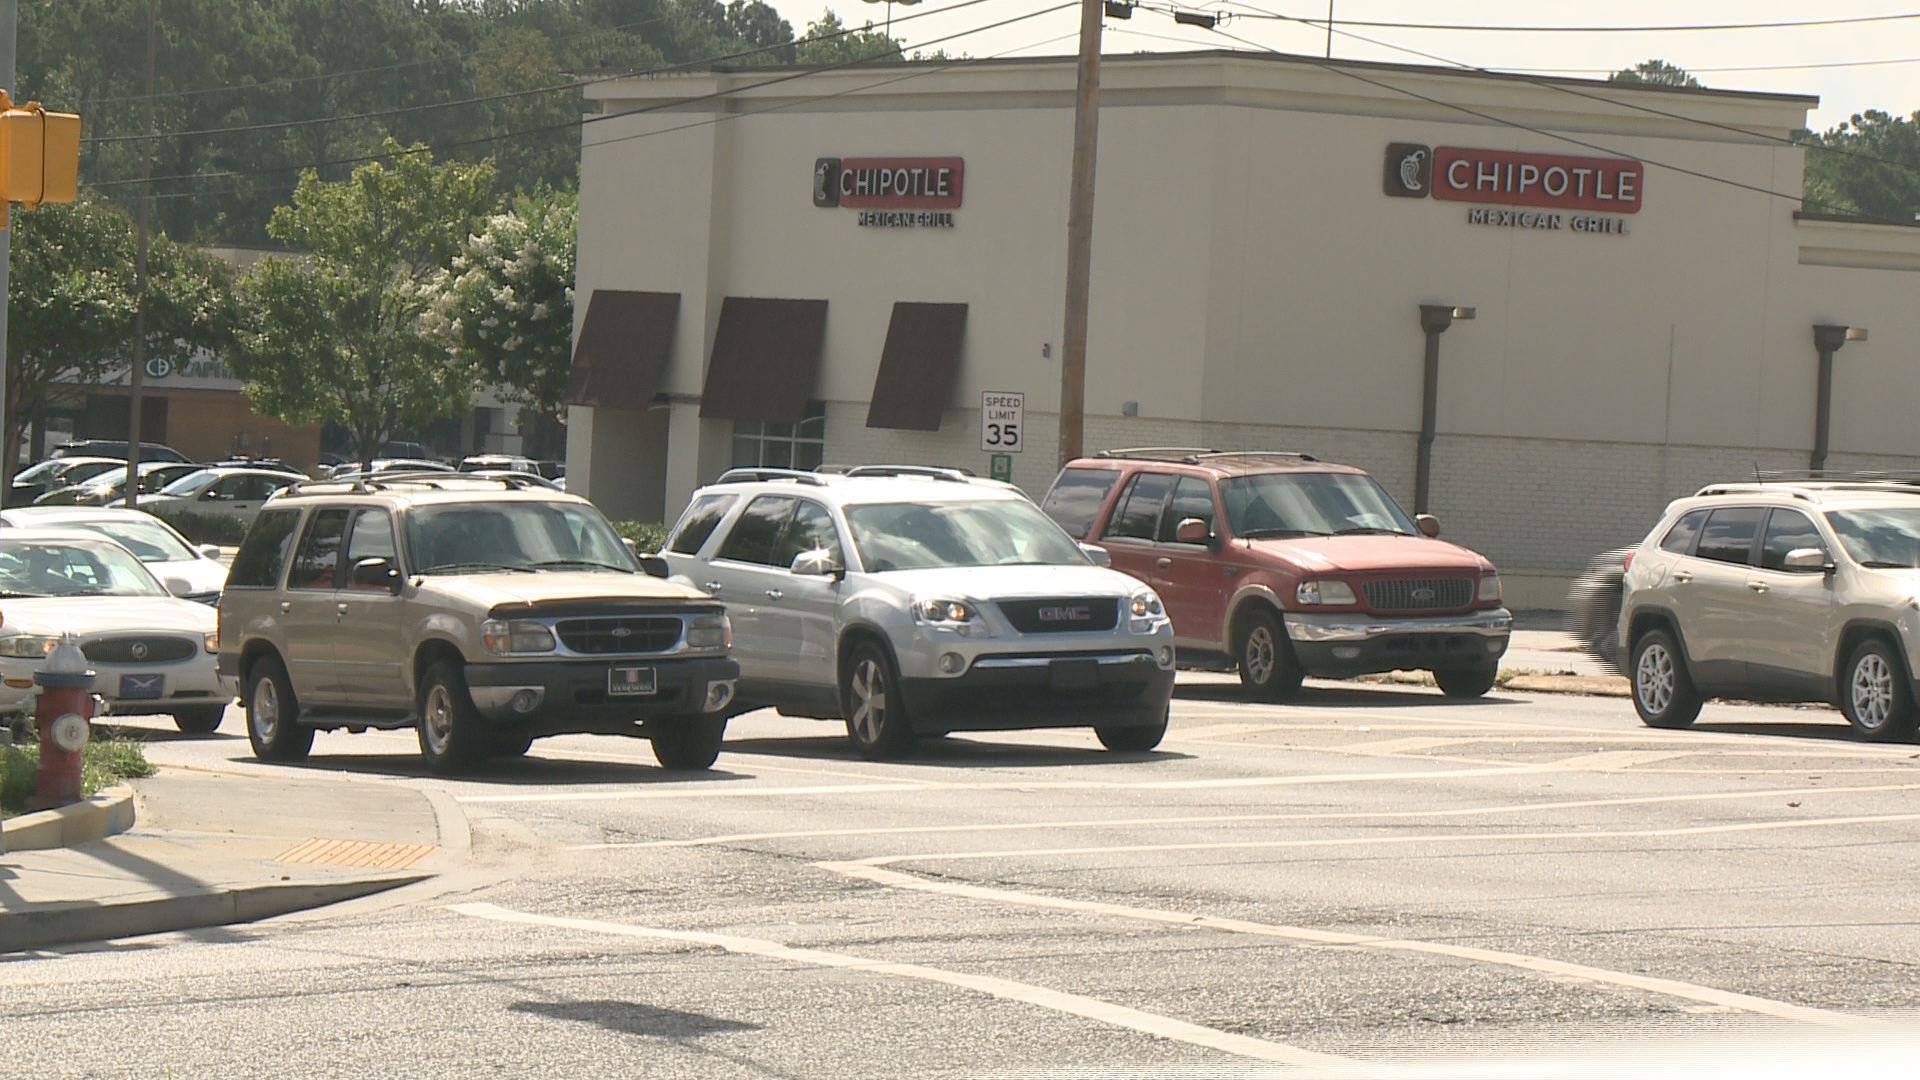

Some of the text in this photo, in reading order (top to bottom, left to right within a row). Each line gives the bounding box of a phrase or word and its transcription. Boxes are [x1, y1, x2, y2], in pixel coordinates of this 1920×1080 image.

[840, 168, 950, 196] CHIPOTLE
[1447, 159, 1638, 201] CHIPOTLE
[858, 211, 954, 228] MEXICAN GRILL
[1468, 208, 1631, 235] MEXICAN GRILL
[985, 397, 1021, 408] SPEED
[989, 411, 1016, 420] LIMIT
[986, 424, 1018, 446] 35
[1039, 606, 1089, 620] GMC
